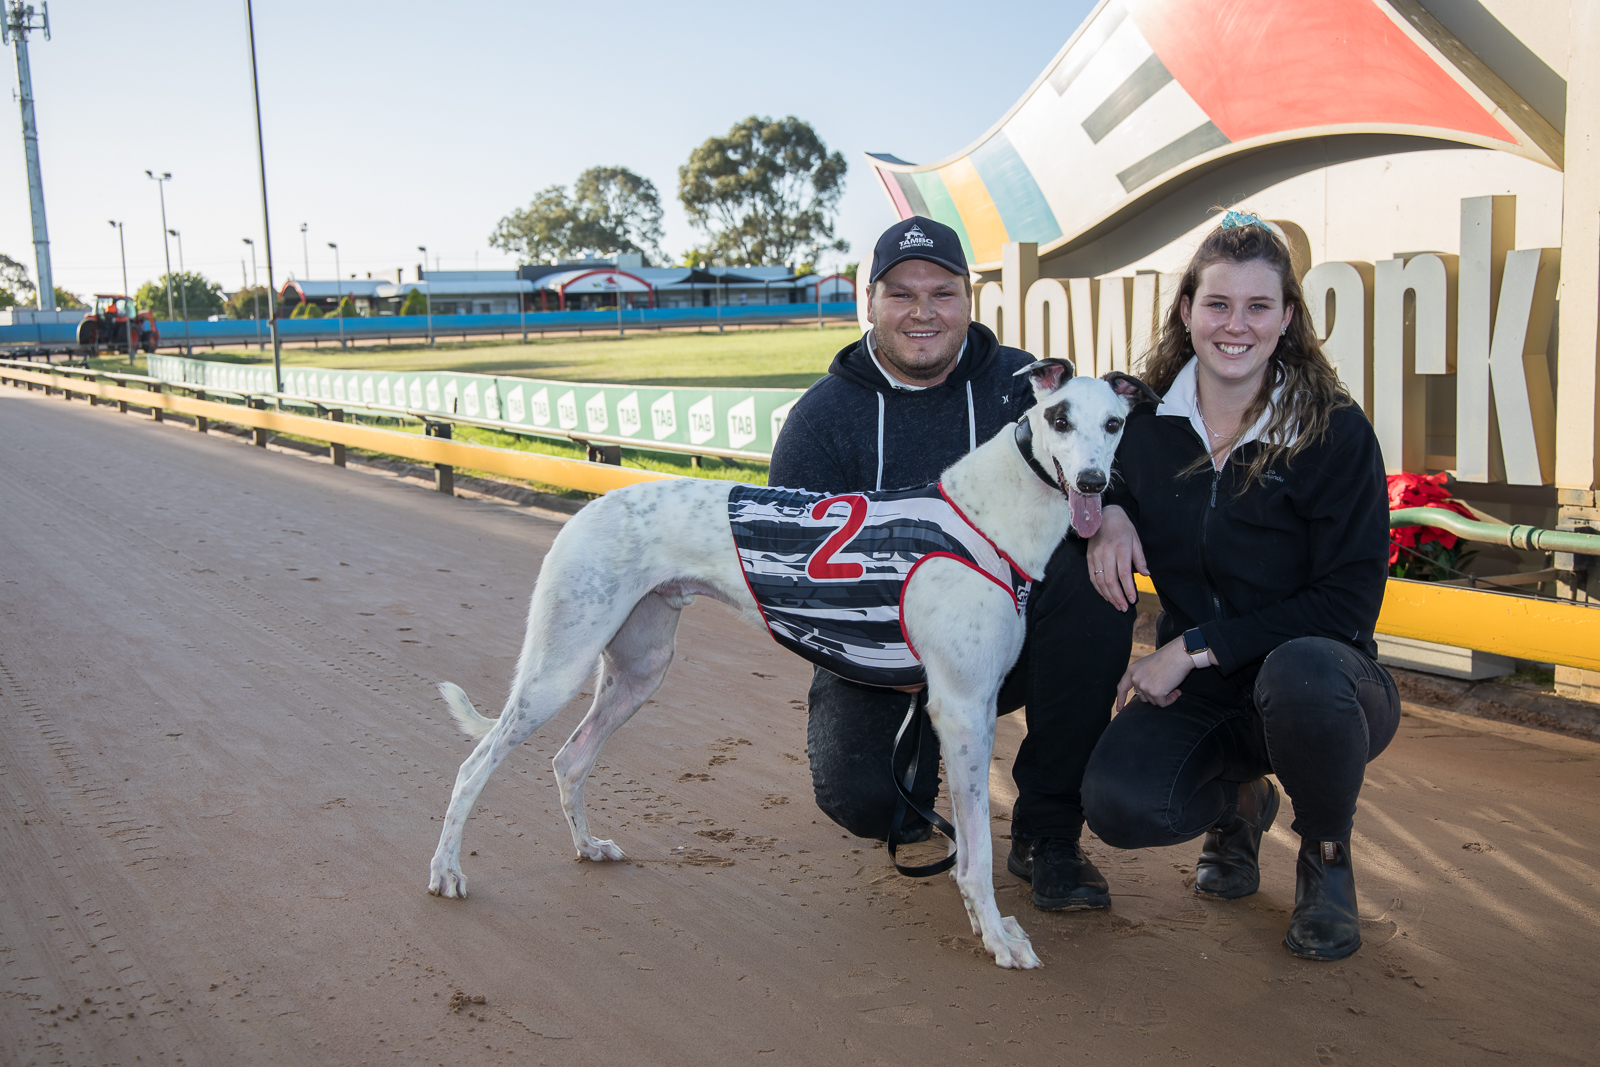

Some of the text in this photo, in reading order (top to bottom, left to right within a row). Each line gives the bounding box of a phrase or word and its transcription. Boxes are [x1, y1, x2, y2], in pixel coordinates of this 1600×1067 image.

[899, 237, 934, 247] TAMBO
[1266, 194, 1542, 486] ark
[588, 407, 605, 423] TAB
[619, 408, 638, 425] TAB
[654, 409, 673, 427] TAB
[691, 413, 712, 432] TAB
[731, 415, 753, 435] TAB
[807, 494, 868, 580] 2
